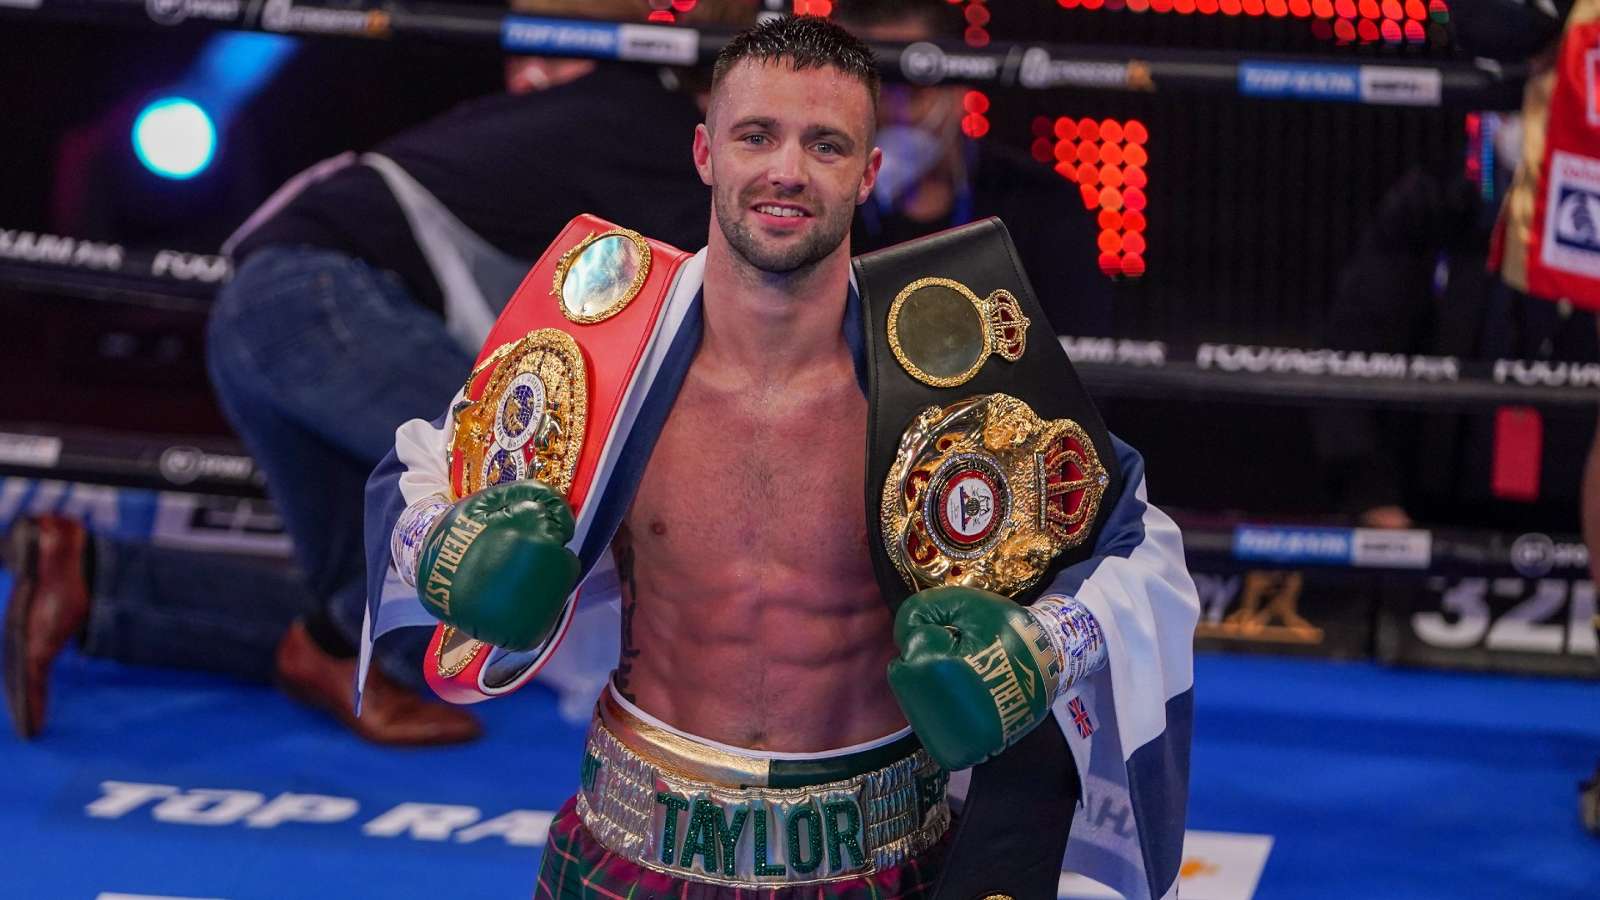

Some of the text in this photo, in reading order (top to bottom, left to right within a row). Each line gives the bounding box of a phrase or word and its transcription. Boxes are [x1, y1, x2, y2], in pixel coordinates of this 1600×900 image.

[425, 512, 488, 617] EVERLAST
[963, 637, 1035, 742] EVERLAST
[86, 780, 359, 829] TOP
[656, 791, 865, 878] TAYLOR
